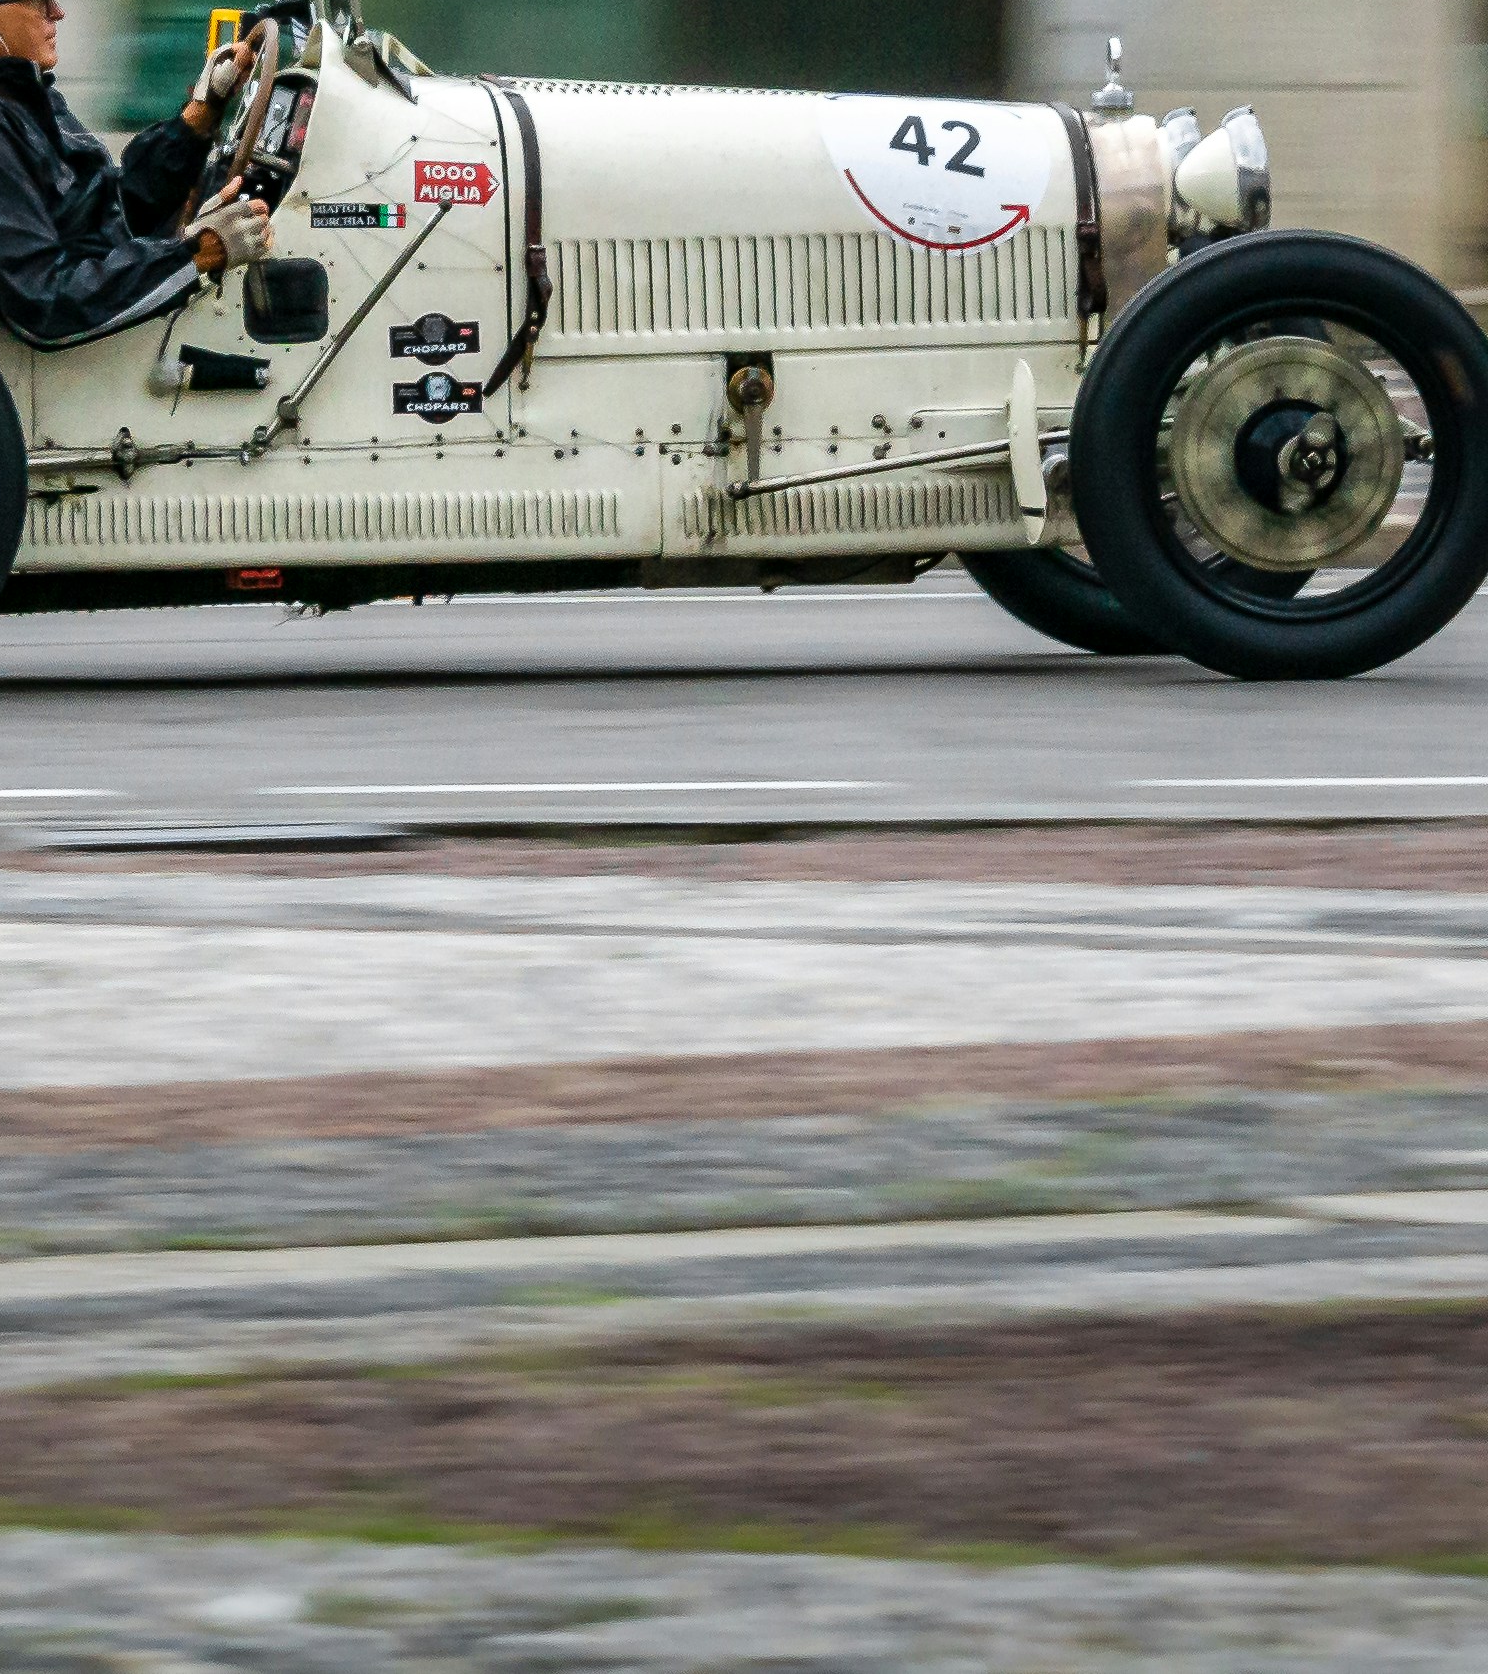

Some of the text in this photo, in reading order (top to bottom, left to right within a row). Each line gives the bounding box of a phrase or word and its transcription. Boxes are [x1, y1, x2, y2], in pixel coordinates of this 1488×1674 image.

[889, 115, 985, 178] 42
[423, 165, 477, 181] 1000
[419, 184, 481, 201] MIGLIA
[404, 342, 467, 354] CHOPARD
[407, 402, 469, 412] CHOPARD
